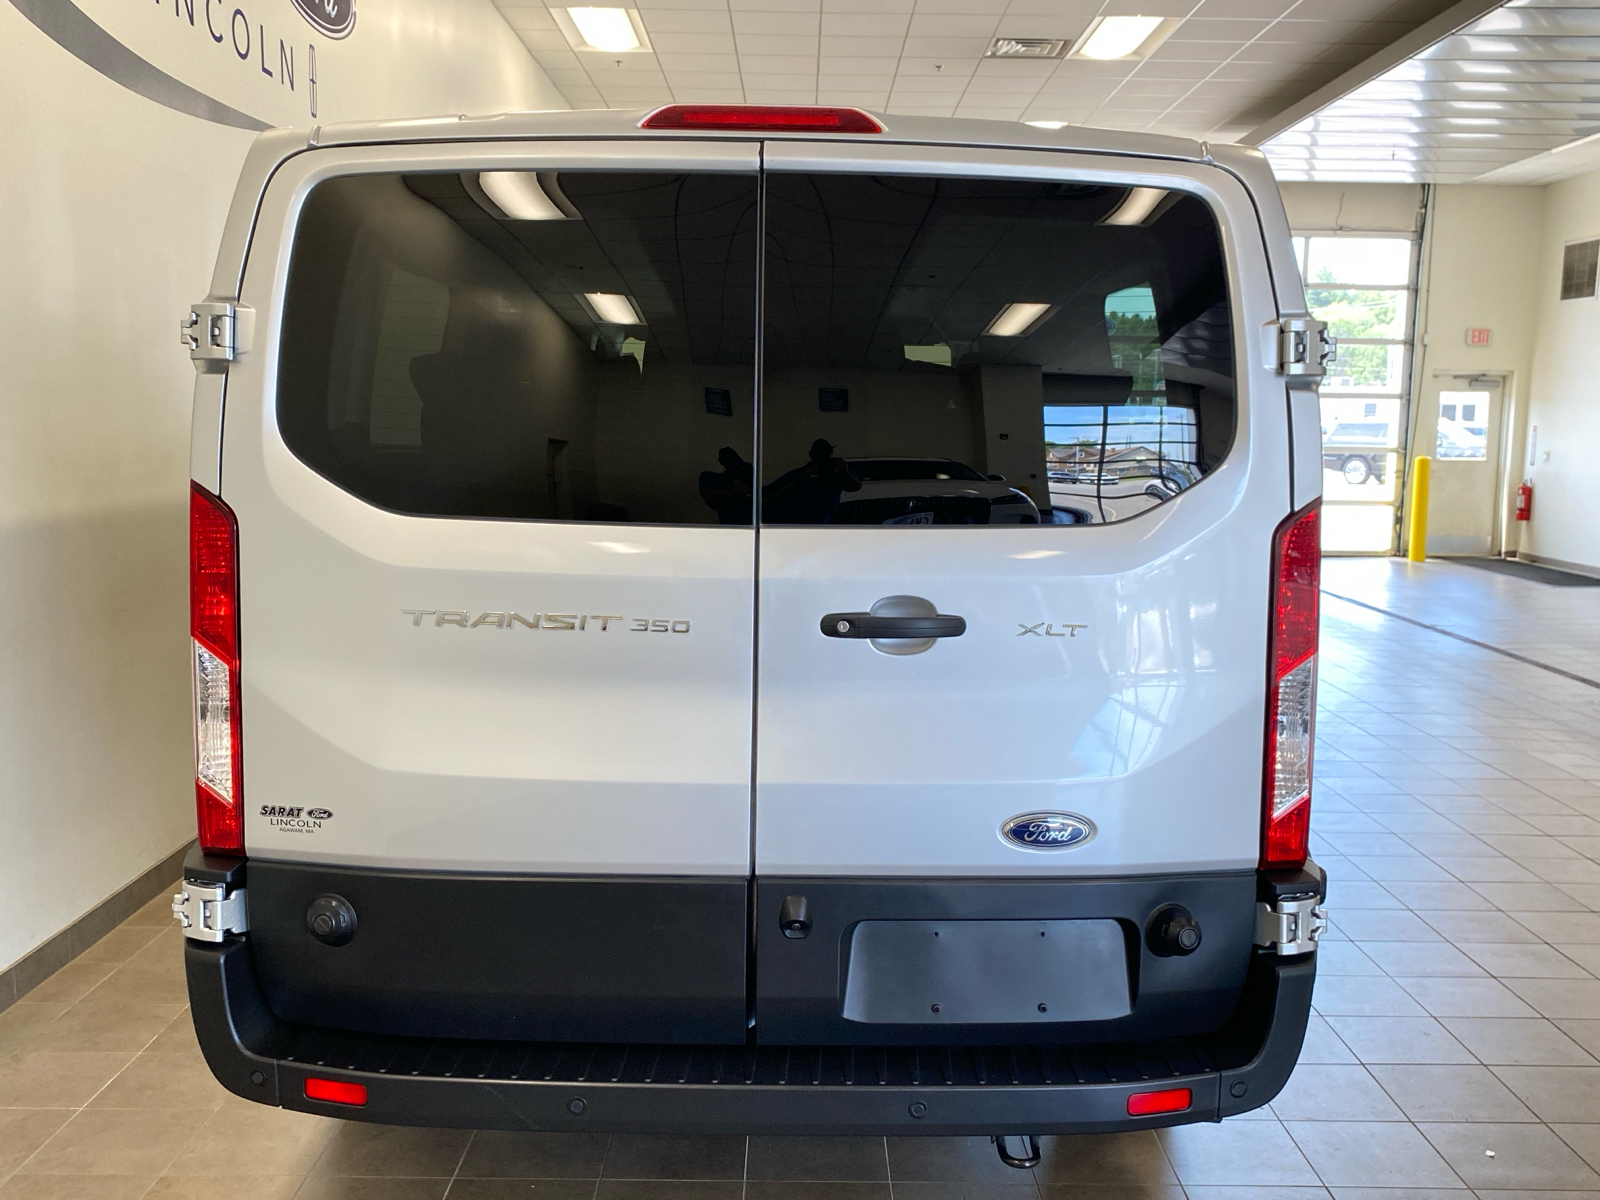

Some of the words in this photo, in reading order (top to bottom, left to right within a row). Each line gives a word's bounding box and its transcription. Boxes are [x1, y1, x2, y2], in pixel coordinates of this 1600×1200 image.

[1470, 328, 1491, 344] EXIT
[401, 609, 624, 632] TRANSIT
[630, 618, 691, 633] 350
[1016, 622, 1088, 637] XLT
[260, 804, 304, 818] SARAT
[270, 818, 322, 828] LINCOLN
[1024, 821, 1073, 842] Ford
